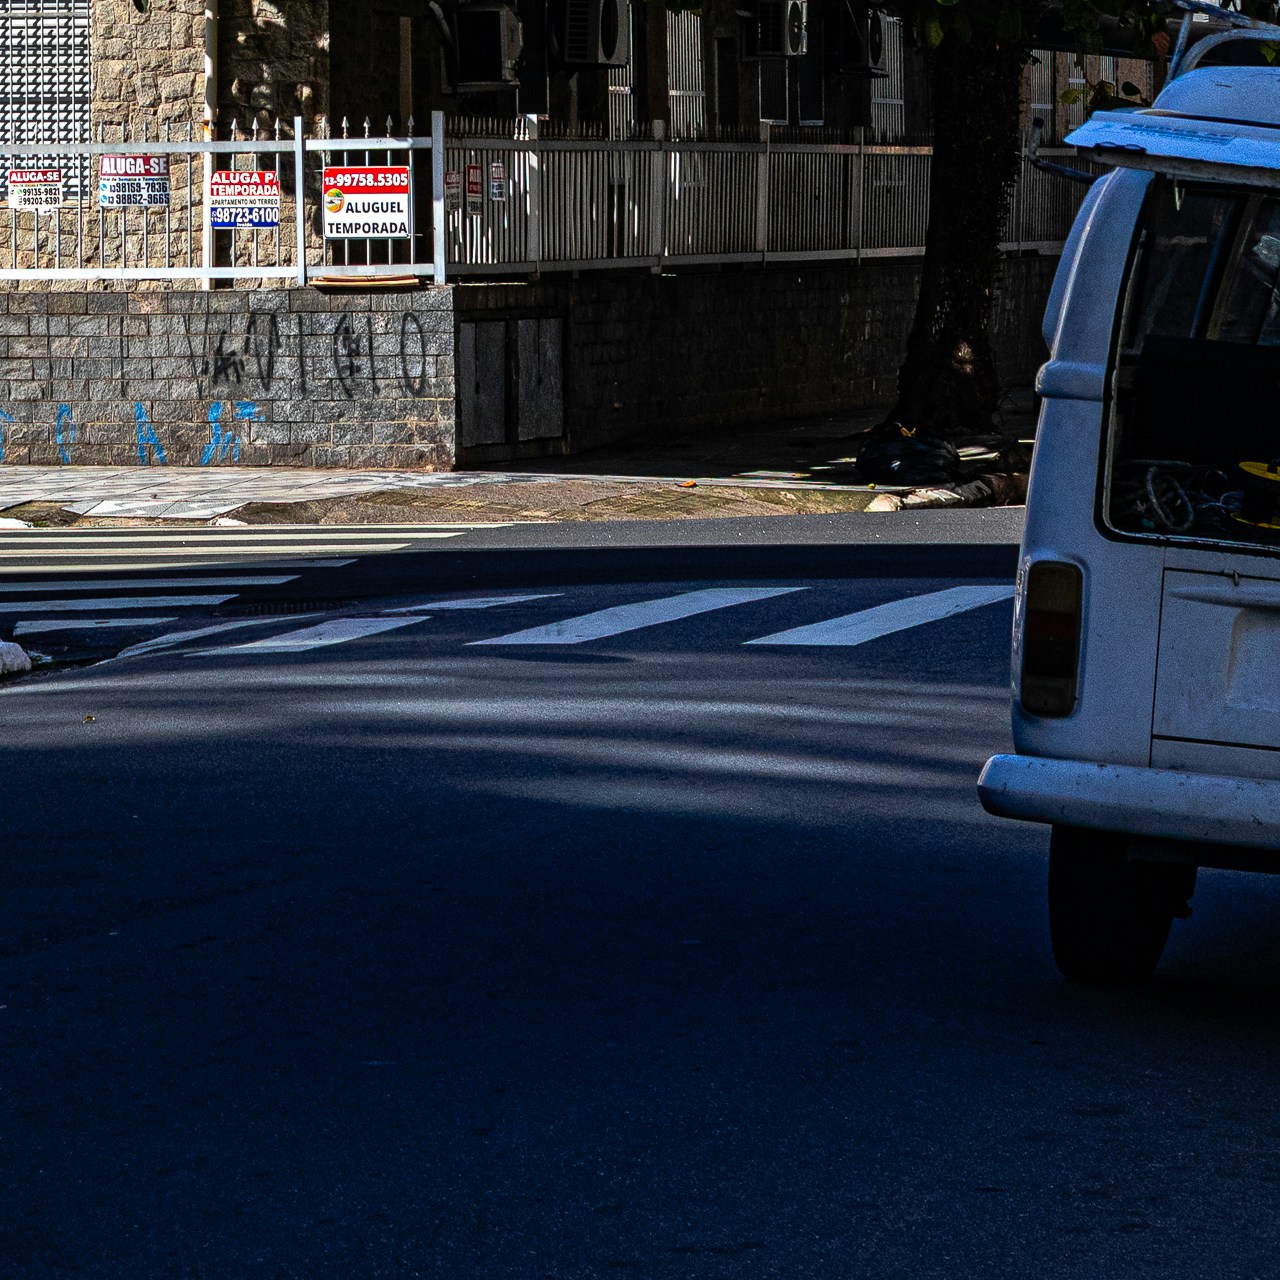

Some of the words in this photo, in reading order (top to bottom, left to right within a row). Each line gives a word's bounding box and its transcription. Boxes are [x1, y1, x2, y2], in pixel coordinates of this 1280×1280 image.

[102, 157, 167, 174] ALUGA-SE
[10, 171, 60, 182] ALUGA-SE
[211, 172, 261, 184] ALUGA
[324, 173, 408, 187] 13-99758.5305
[211, 184, 279, 196] TEMPORADA
[346, 202, 404, 213] ALUGUEL
[217, 207, 279, 223] 98723-6100
[327, 222, 408, 234] TEMPORADA
